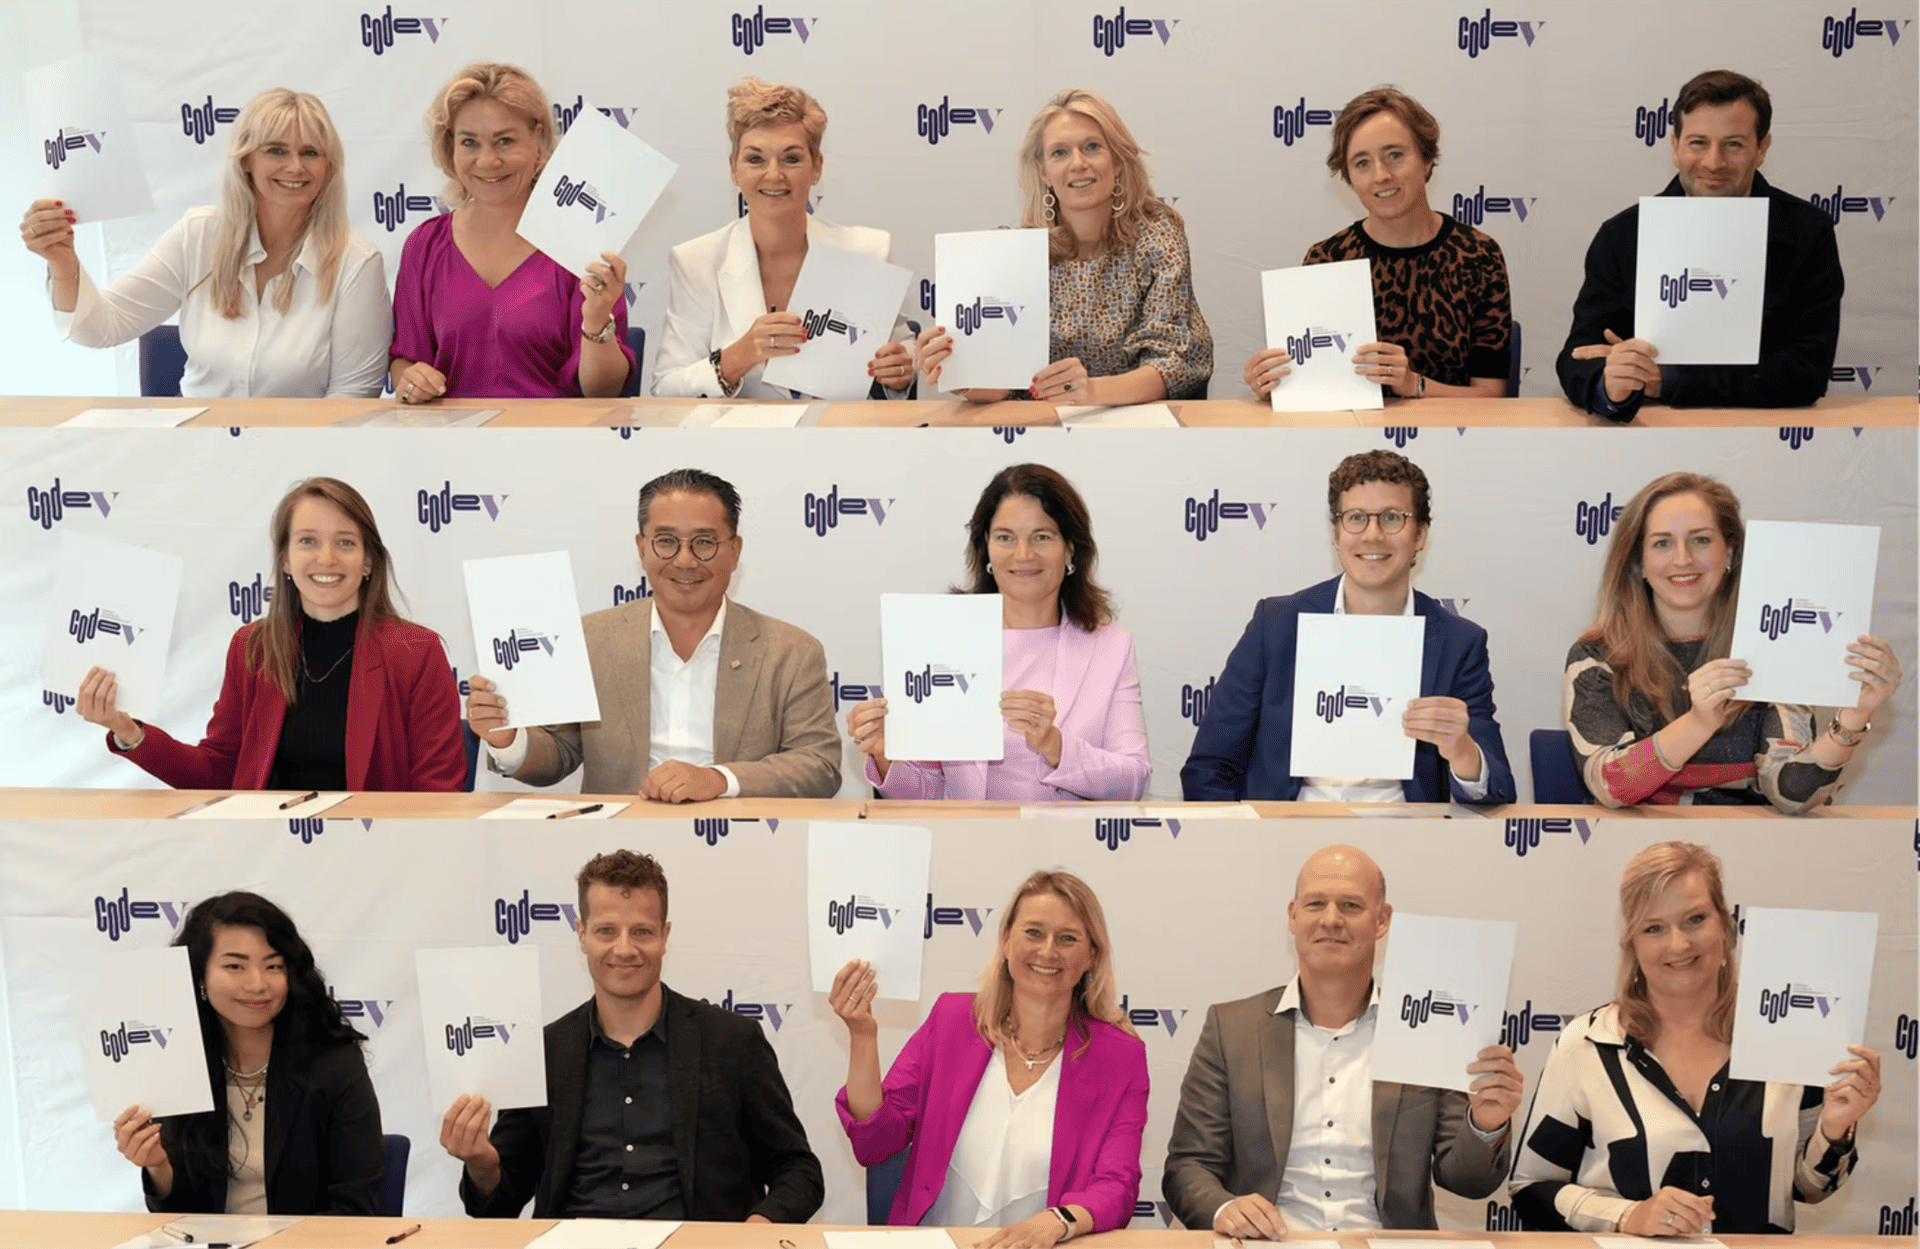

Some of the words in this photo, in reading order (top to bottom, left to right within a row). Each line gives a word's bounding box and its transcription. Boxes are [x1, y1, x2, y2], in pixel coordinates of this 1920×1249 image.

[181, 95, 240, 144] code
[1273, 97, 1341, 146] code
[1635, 98, 1673, 147] cod
[1576, 492, 1624, 546] cod
[229, 573, 273, 625] cod
